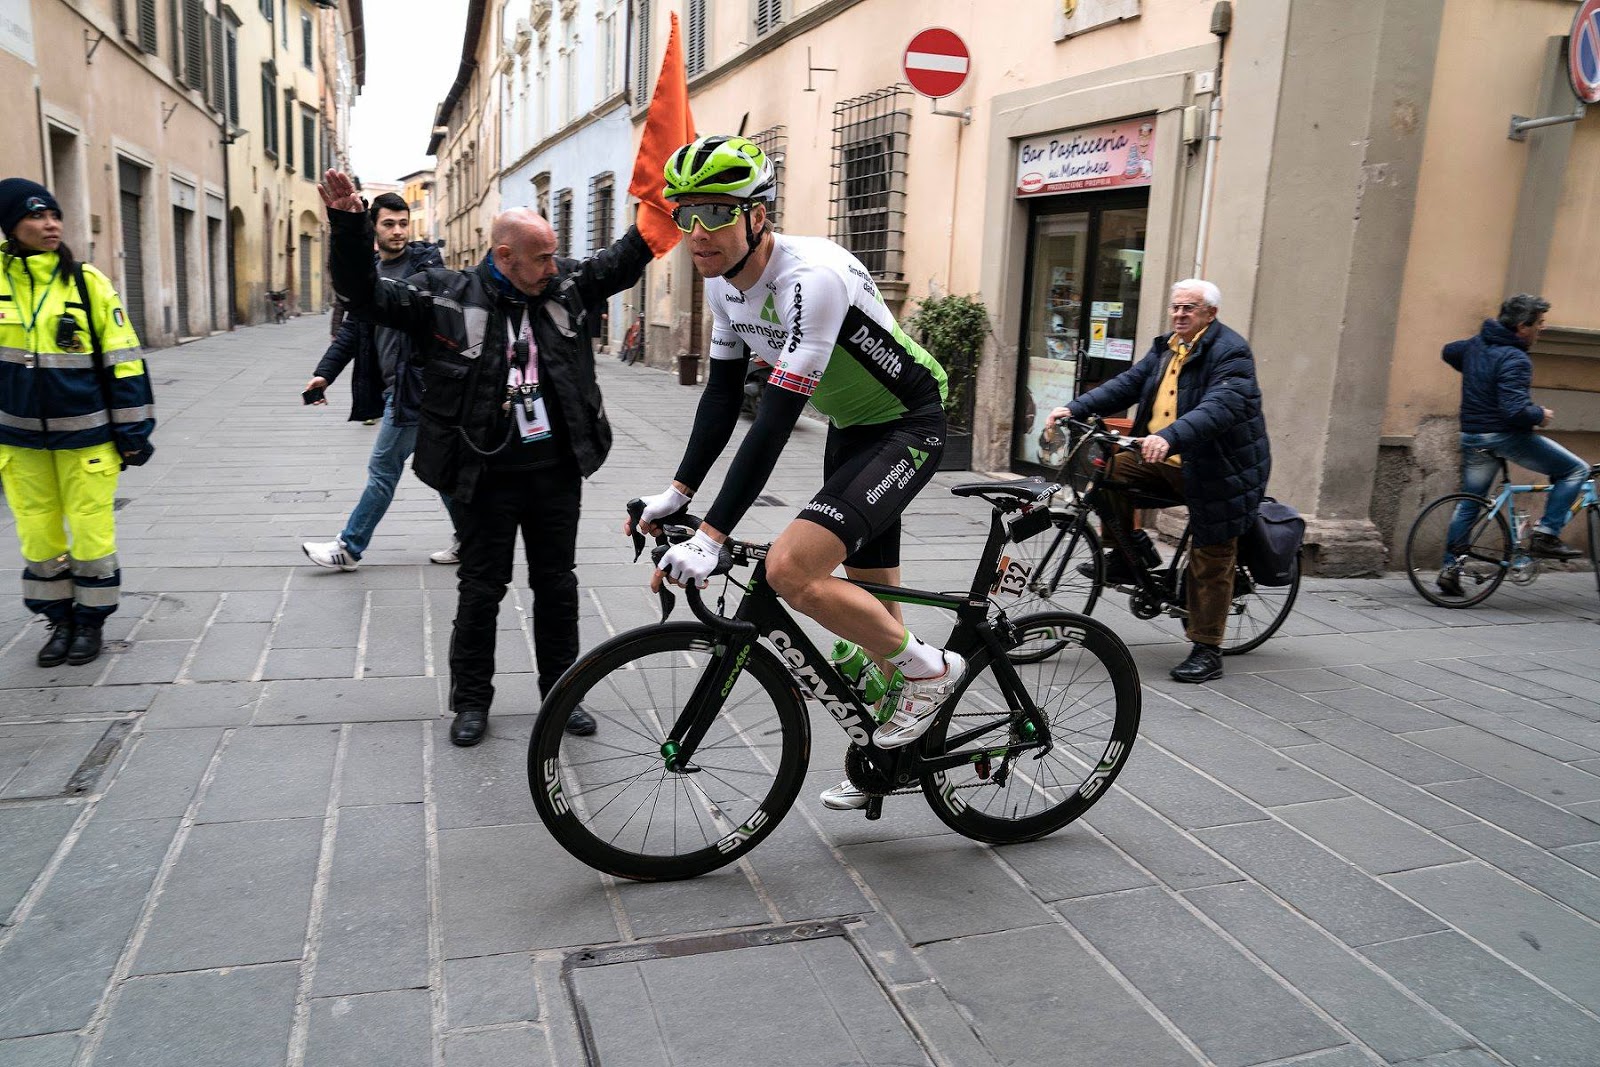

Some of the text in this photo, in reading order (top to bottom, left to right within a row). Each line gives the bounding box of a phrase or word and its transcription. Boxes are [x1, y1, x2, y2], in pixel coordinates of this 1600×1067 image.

[1021, 129, 1130, 164] Bar Pasticceria
[1060, 160, 1112, 178] Marchese
[865, 458, 910, 505] dimension
[897, 467, 916, 490] data
[805, 500, 846, 525] eloitte.
[1000, 561, 1032, 598] 132
